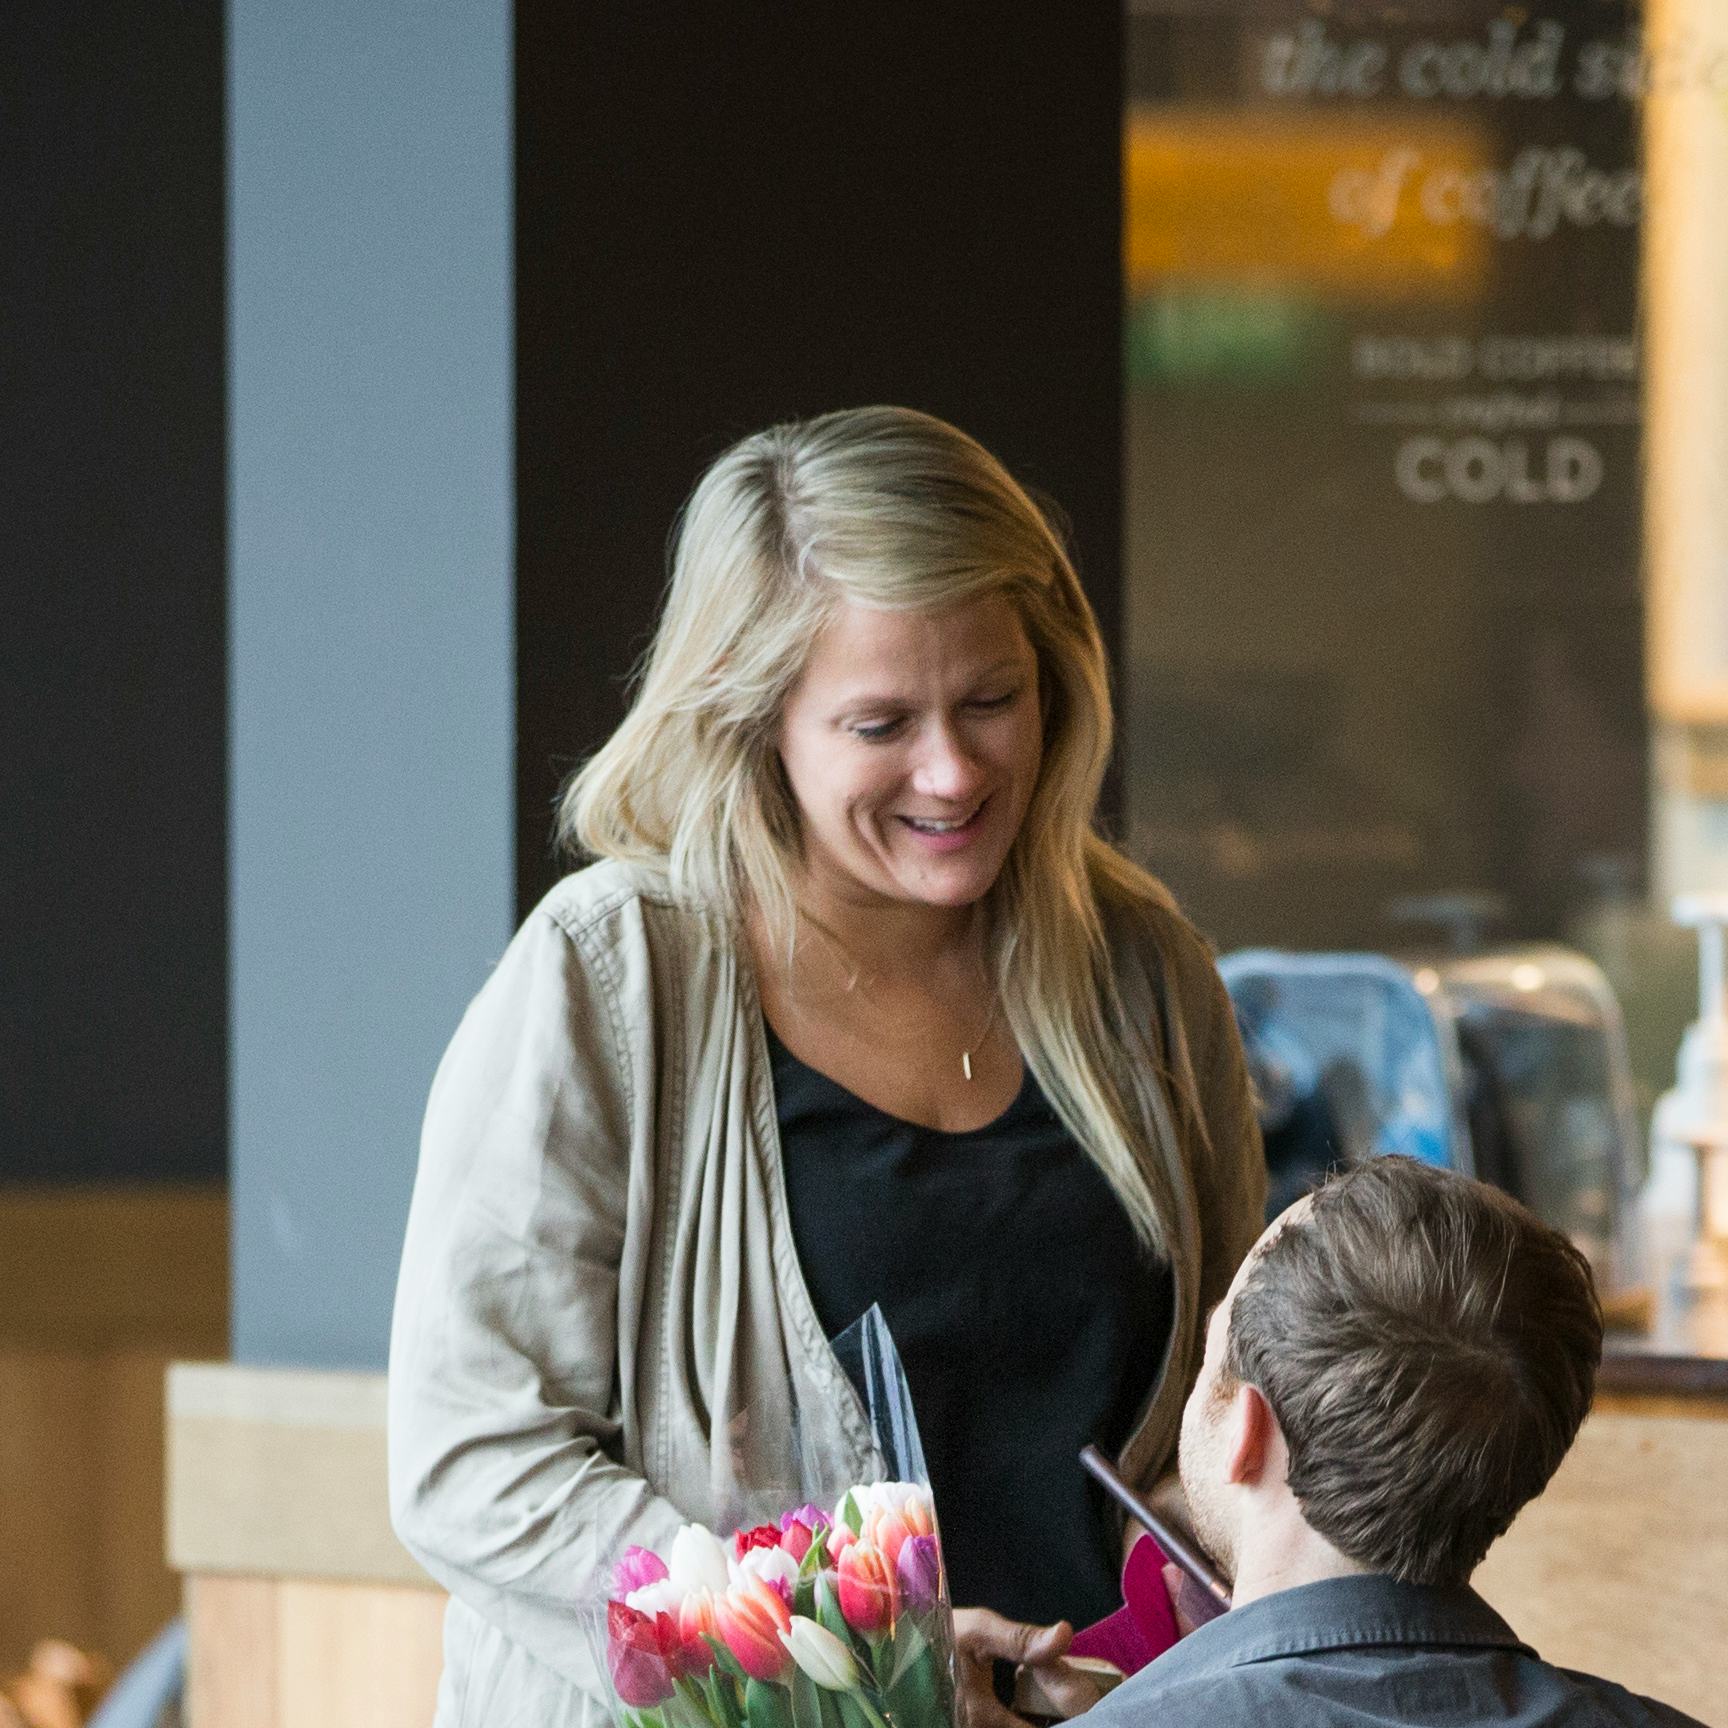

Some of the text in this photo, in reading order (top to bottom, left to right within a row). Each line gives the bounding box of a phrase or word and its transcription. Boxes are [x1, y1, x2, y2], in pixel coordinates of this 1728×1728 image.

[1263, 18, 1387, 97] the
[1401, 16, 1564, 98] cold
[1328, 146, 1640, 239] of coffee
[1396, 437, 1603, 502] COLD
